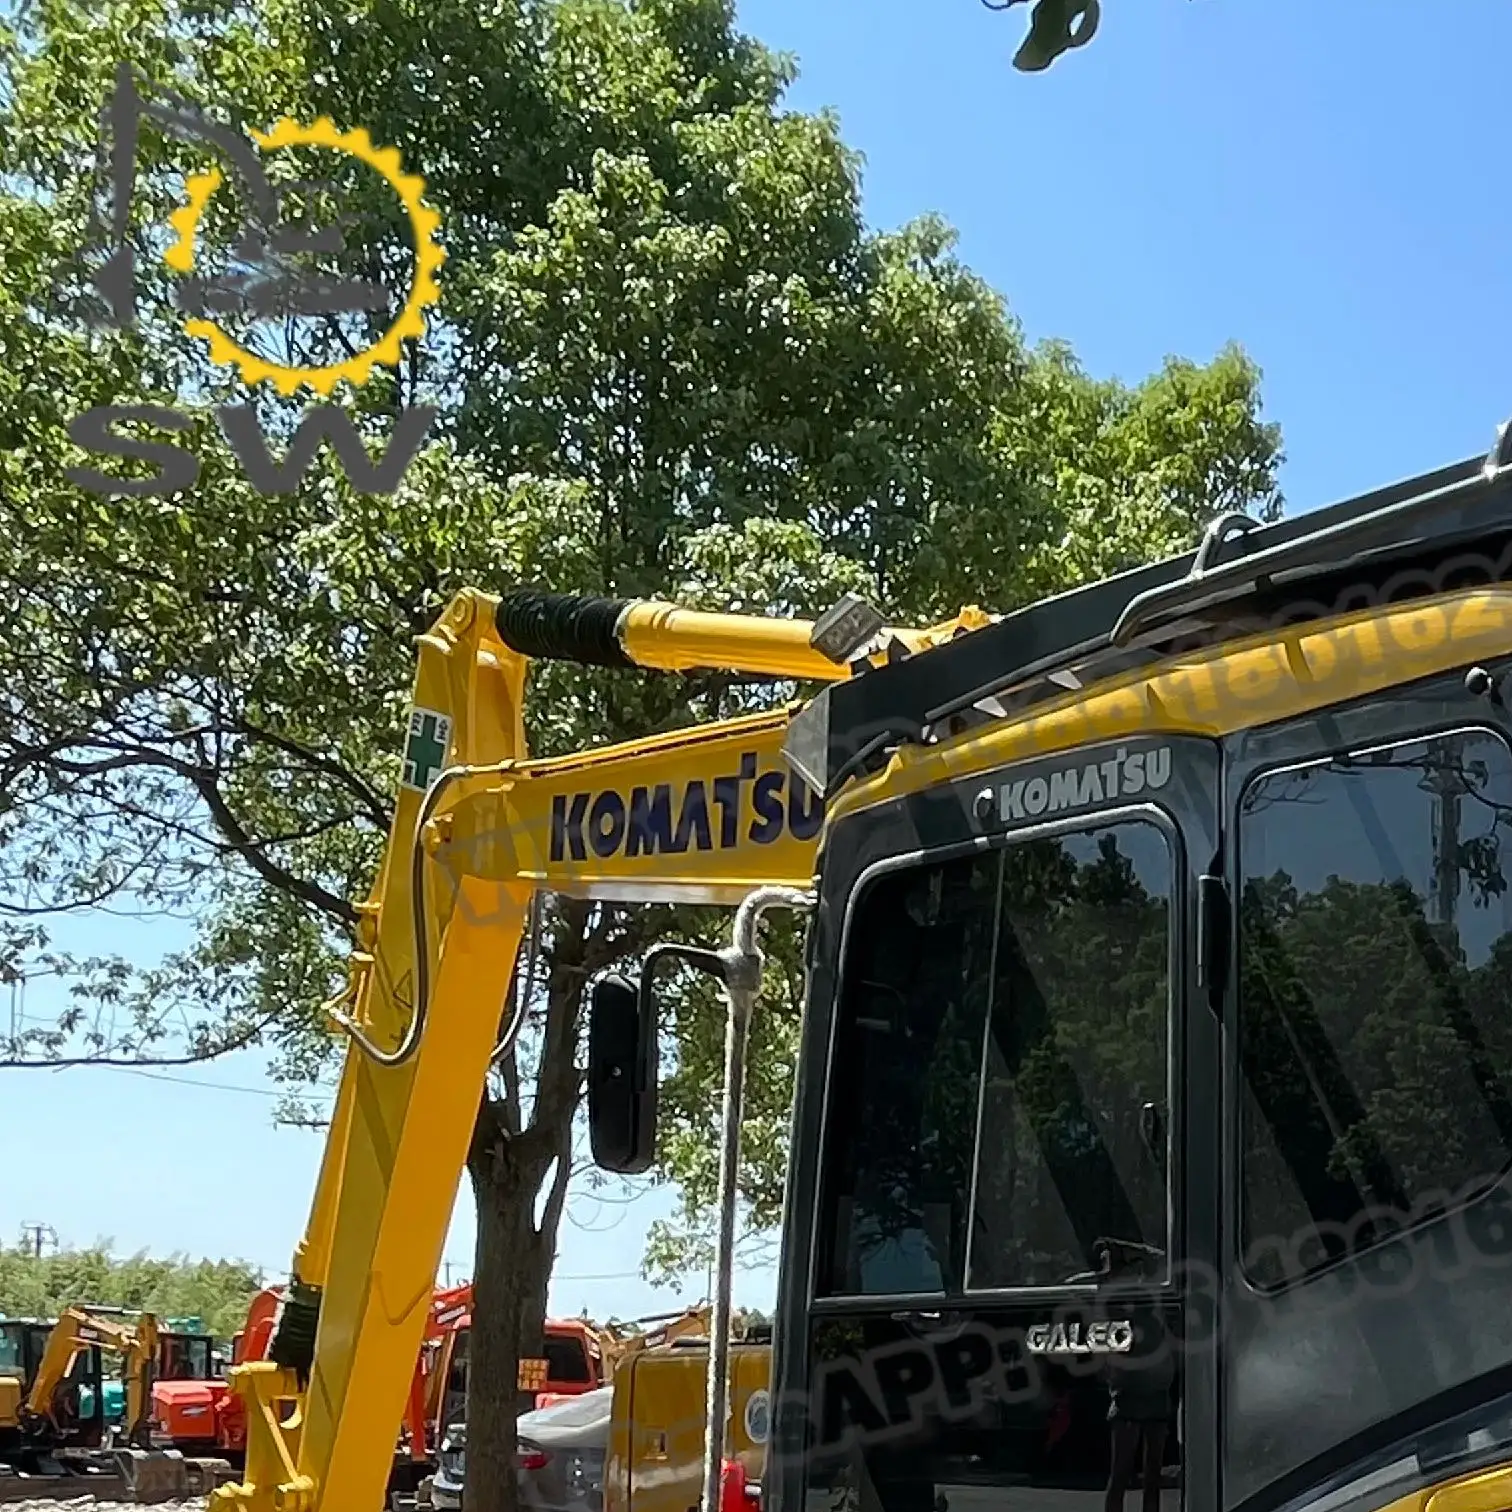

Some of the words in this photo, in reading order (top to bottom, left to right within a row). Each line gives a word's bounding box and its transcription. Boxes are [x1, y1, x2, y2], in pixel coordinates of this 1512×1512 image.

[550, 752, 825, 862] KOMATSU
[1000, 747, 1172, 822] KOMATSU
[1026, 1320, 1133, 1353] GALEO
